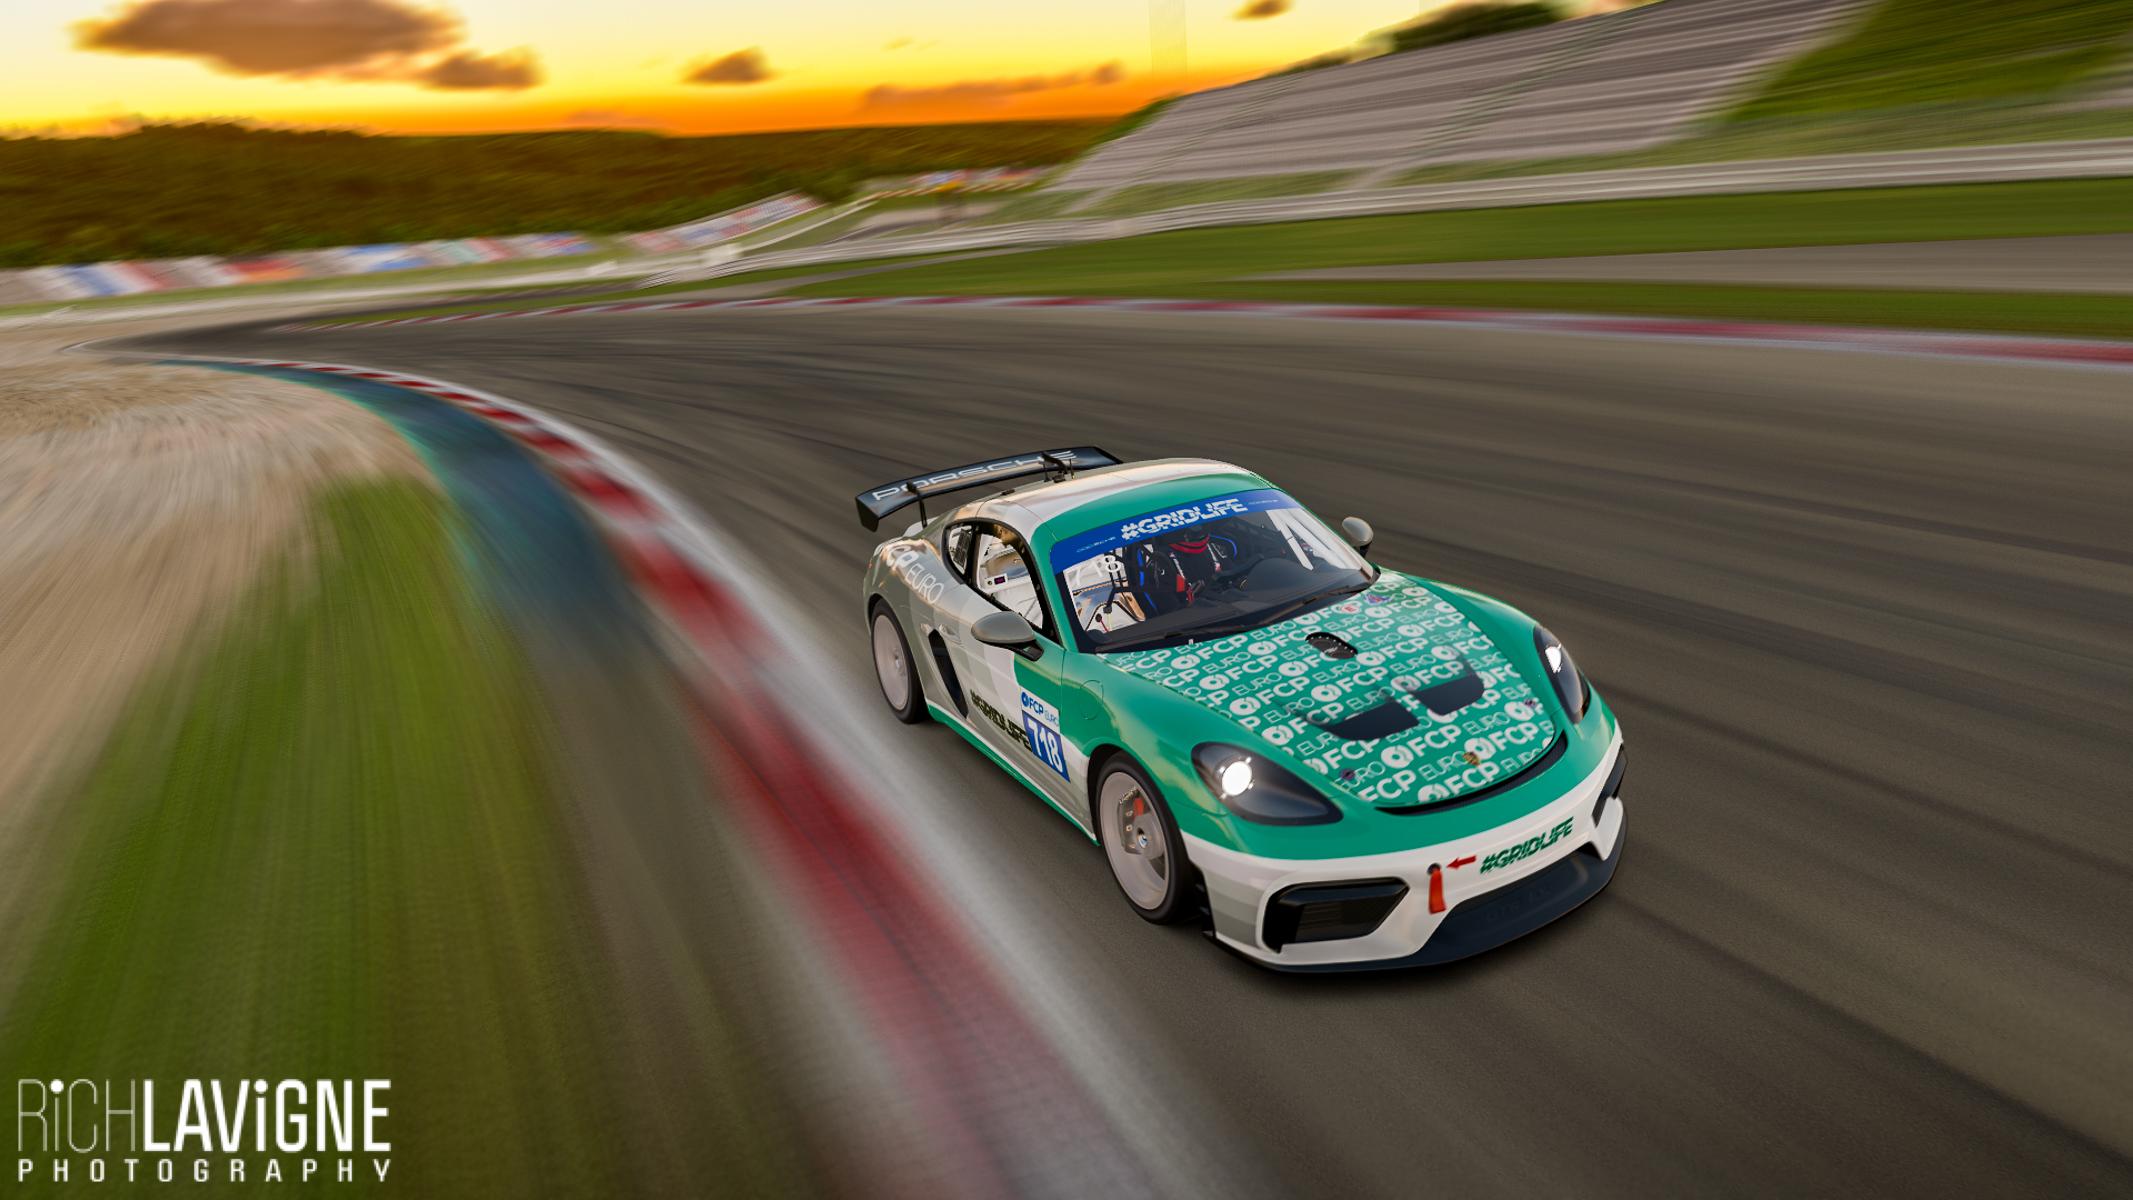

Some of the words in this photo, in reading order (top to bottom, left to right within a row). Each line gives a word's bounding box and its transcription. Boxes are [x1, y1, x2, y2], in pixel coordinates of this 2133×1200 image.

[872, 450, 1077, 500] PORSCHE
[1121, 498, 1248, 541] #GRIDLIFE
[905, 563, 944, 604] EURO
[1324, 614, 1368, 630] EURO
[1347, 618, 1395, 637] FCP
[1421, 612, 1465, 631] FCP
[1197, 634, 1248, 660] FCP
[1250, 620, 1296, 641] EURO
[1356, 632, 1402, 650] EURO
[1380, 637, 1429, 659] FCP
[1202, 652, 1251, 673] EURO
[1225, 655, 1278, 680] FCP
[1336, 666, 1389, 693] FCP
[1389, 653, 1437, 674] EURO
[1415, 661, 1464, 685] FCP
[1232, 672, 1282, 695] EURO
[1256, 676, 1310, 705] FCP
[1312, 661, 1360, 683] EURO
[1029, 697, 1044, 715] FCP
[1264, 697, 1315, 723] EURO
[1288, 703, 1344, 735] FCP
[1346, 686, 1397, 711] EURO
[1027, 717, 1063, 773] 718
[1407, 724, 1462, 757] FCP
[1462, 711, 1510, 735] EURO
[1488, 721, 1539, 751] FCP
[1358, 770, 1417, 802] FCP
[1444, 761, 1500, 795] FCP
[1480, 816, 1574, 875] #GRIDLIFE
